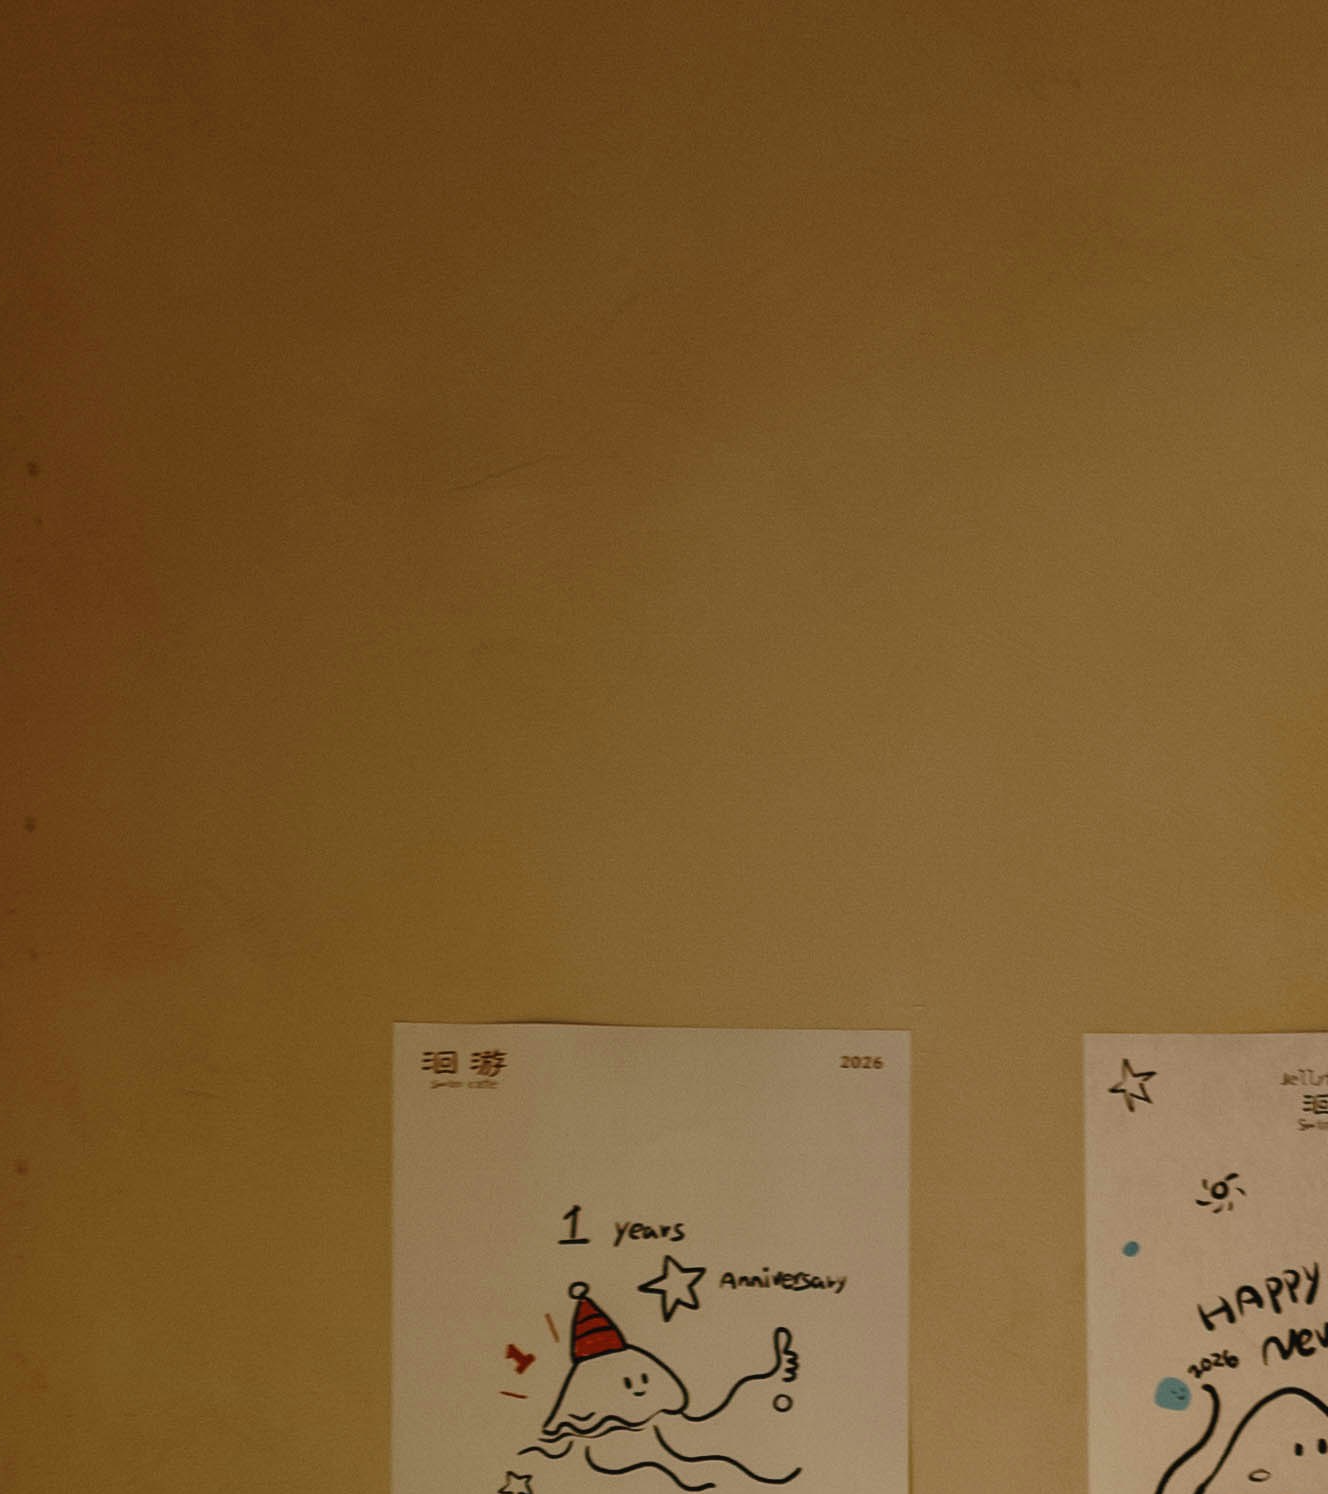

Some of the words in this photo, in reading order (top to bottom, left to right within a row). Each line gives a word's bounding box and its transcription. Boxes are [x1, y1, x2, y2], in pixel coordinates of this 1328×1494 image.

[839, 1055, 885, 1070] 2026
[557, 1204, 591, 1245] 1
[612, 1221, 687, 1248] years
[719, 1266, 848, 1295] Anniversary
[1197, 1261, 1320, 1332] HAPPY
[1187, 1349, 1240, 1379] 2026
